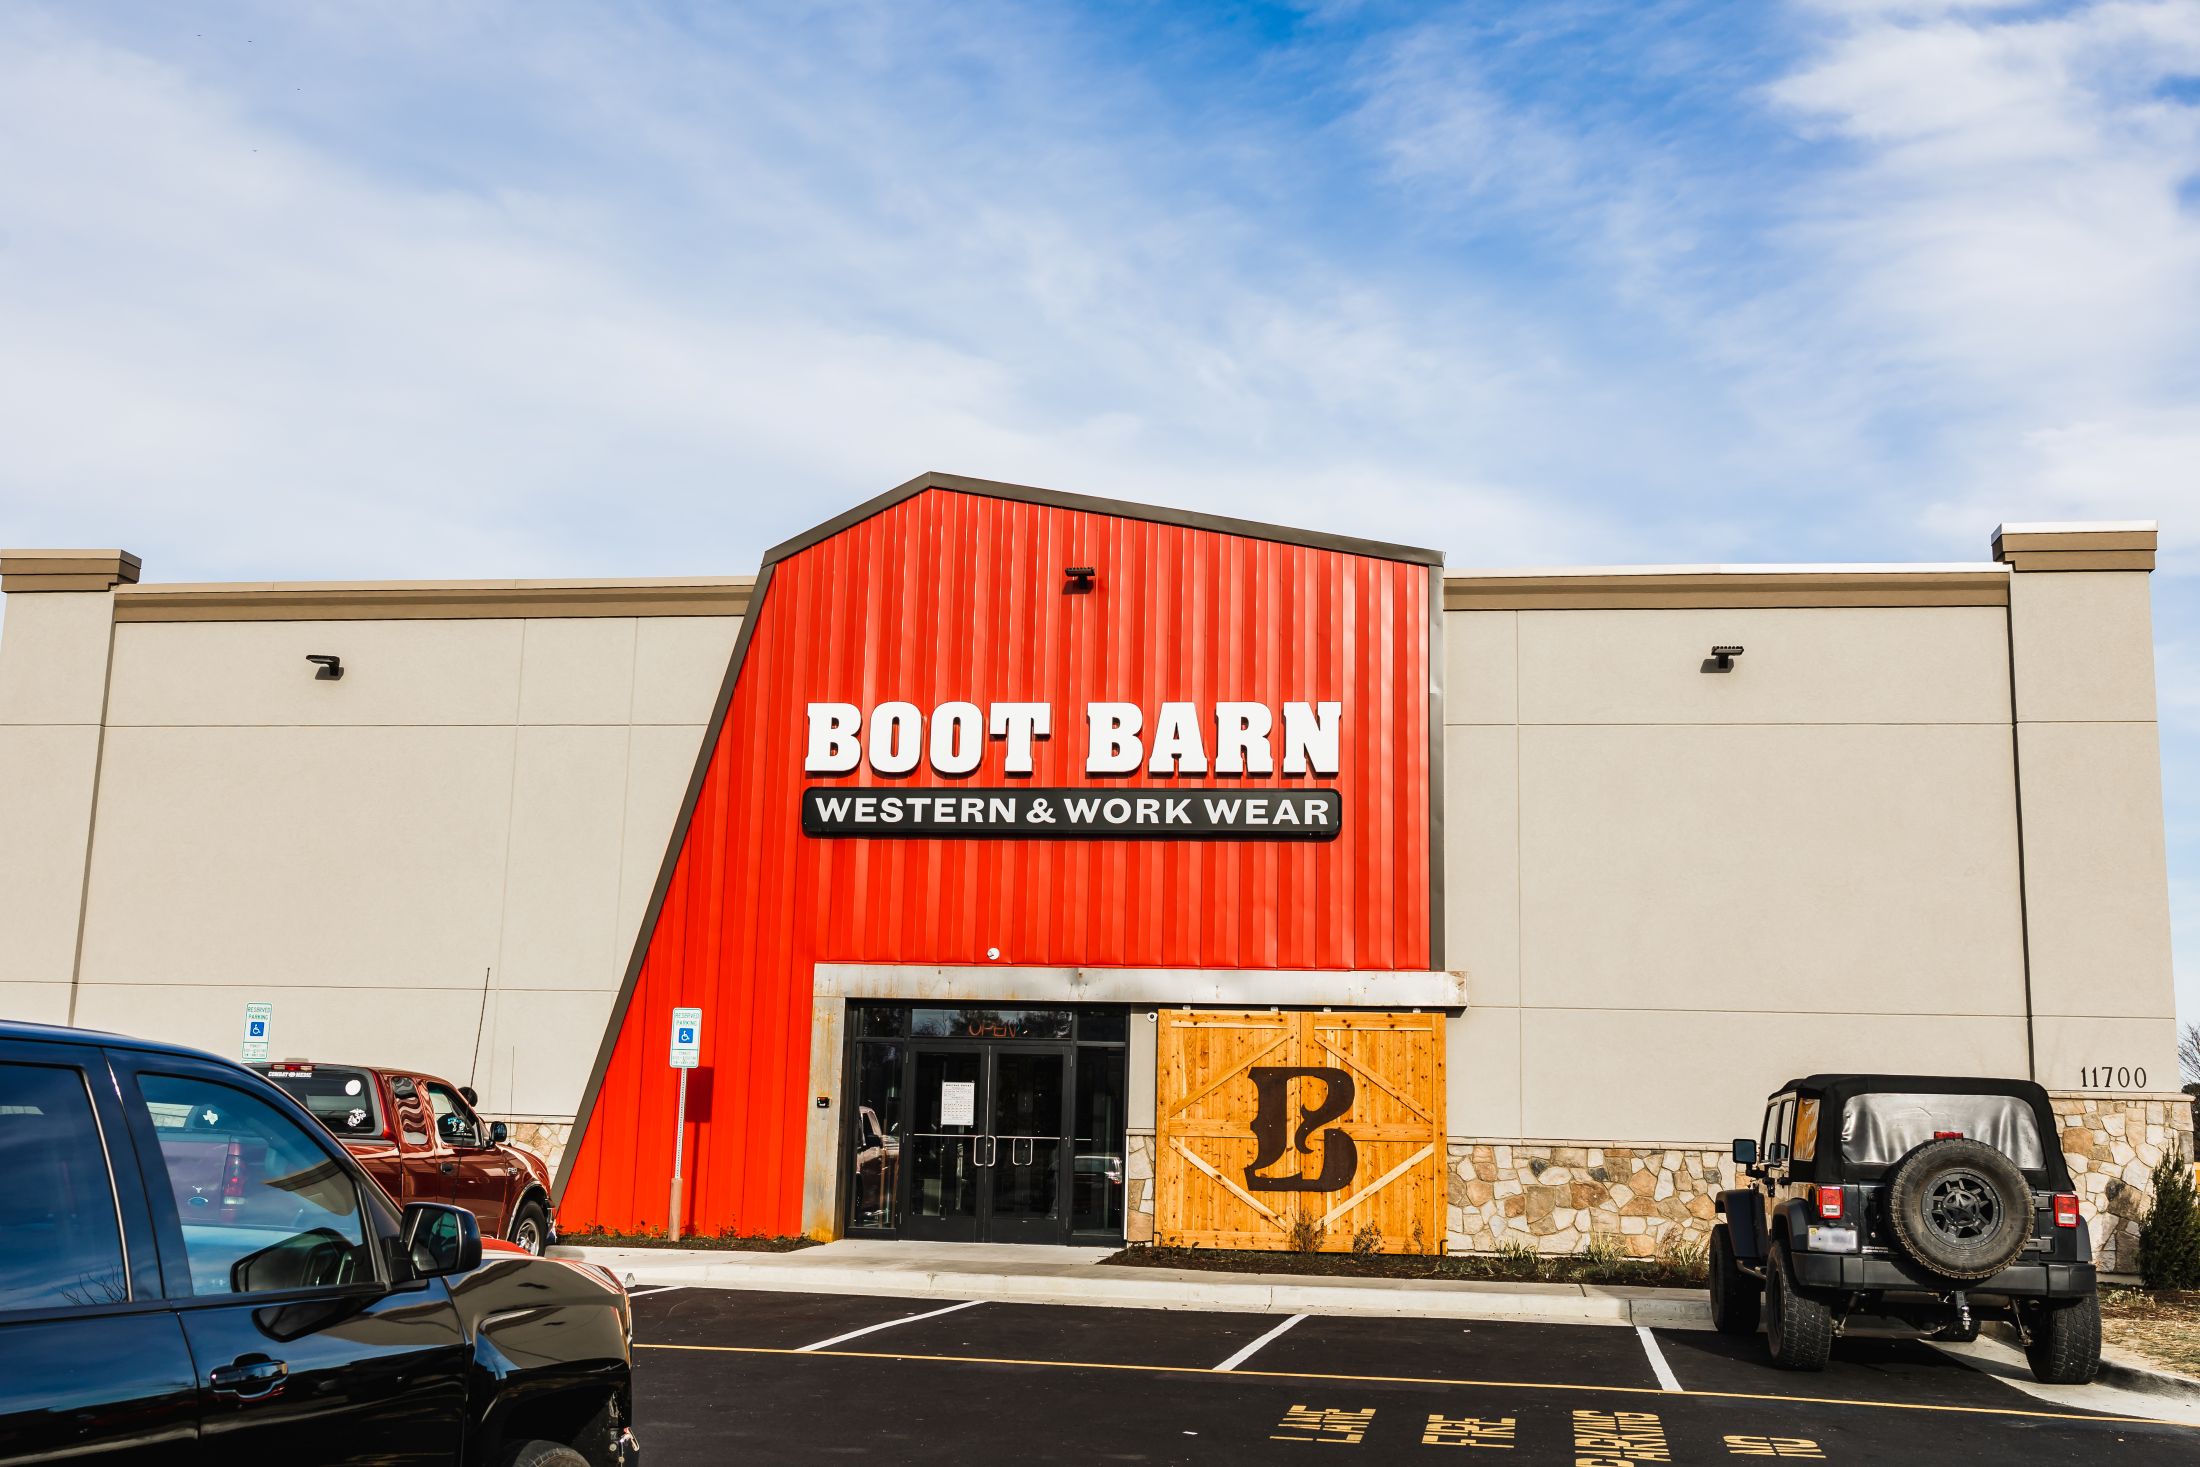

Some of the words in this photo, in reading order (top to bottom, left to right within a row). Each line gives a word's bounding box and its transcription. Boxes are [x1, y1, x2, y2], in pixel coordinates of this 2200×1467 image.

[805, 701, 1051, 773] BOOT
[1086, 701, 1342, 773] BARN
[815, 797, 1016, 823] WESTERN
[1026, 798, 1056, 823] &
[1063, 798, 1192, 824] WORK
[1204, 798, 1329, 825] WEAR
[968, 1020, 1017, 1039] OPEN
[2080, 1066, 2147, 1088] 11700
[1269, 1404, 1377, 1444] LANE
[1421, 1414, 1516, 1449] FIRE
[1572, 1409, 1672, 1467] PARKING
[1722, 1435, 1827, 1459] NO
